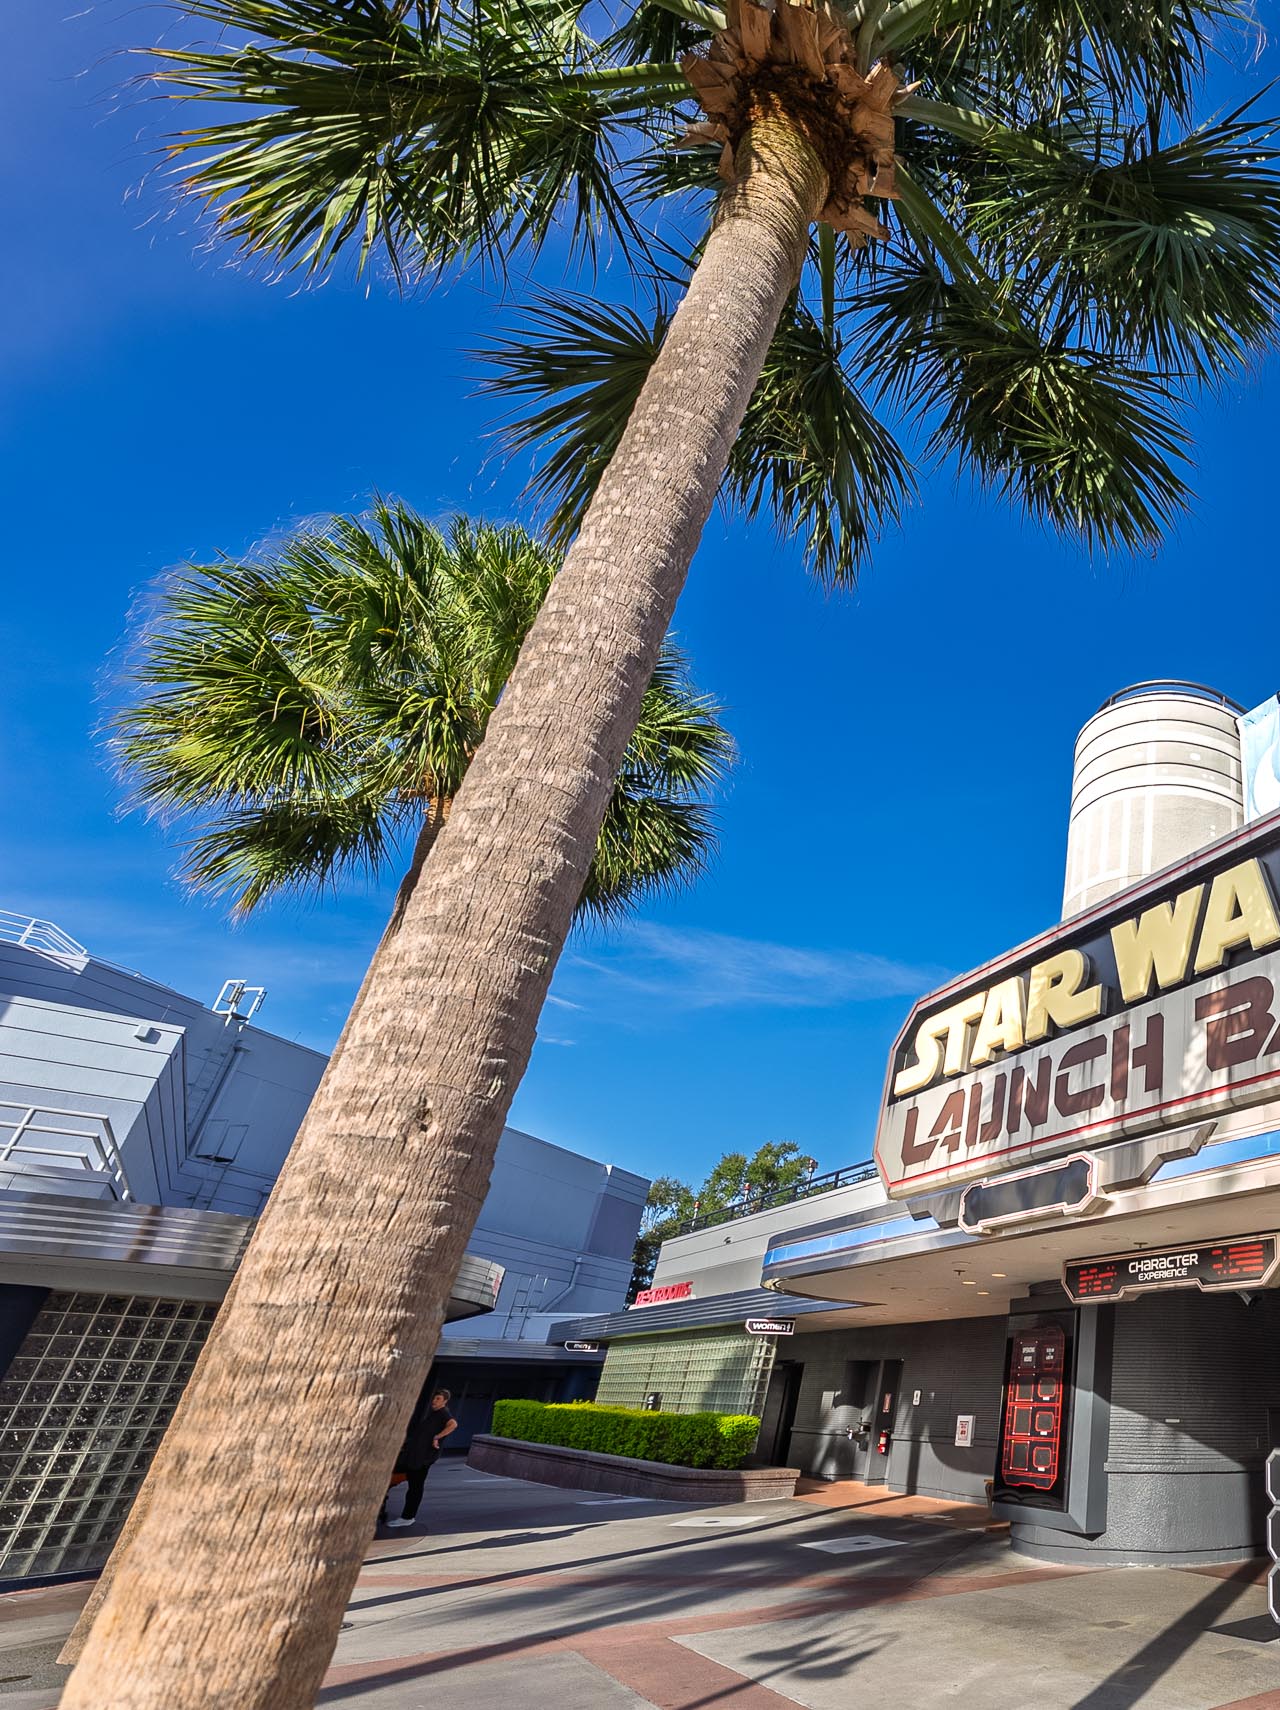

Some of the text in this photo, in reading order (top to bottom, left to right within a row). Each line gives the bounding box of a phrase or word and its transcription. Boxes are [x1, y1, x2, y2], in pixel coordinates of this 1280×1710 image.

[894, 948, 1105, 1097] STAR
[901, 1012, 1164, 1167] LAUNCH
[635, 1281, 695, 1305] RESTROOMS
[1138, 1268, 1188, 1281] EXPERIENCE
